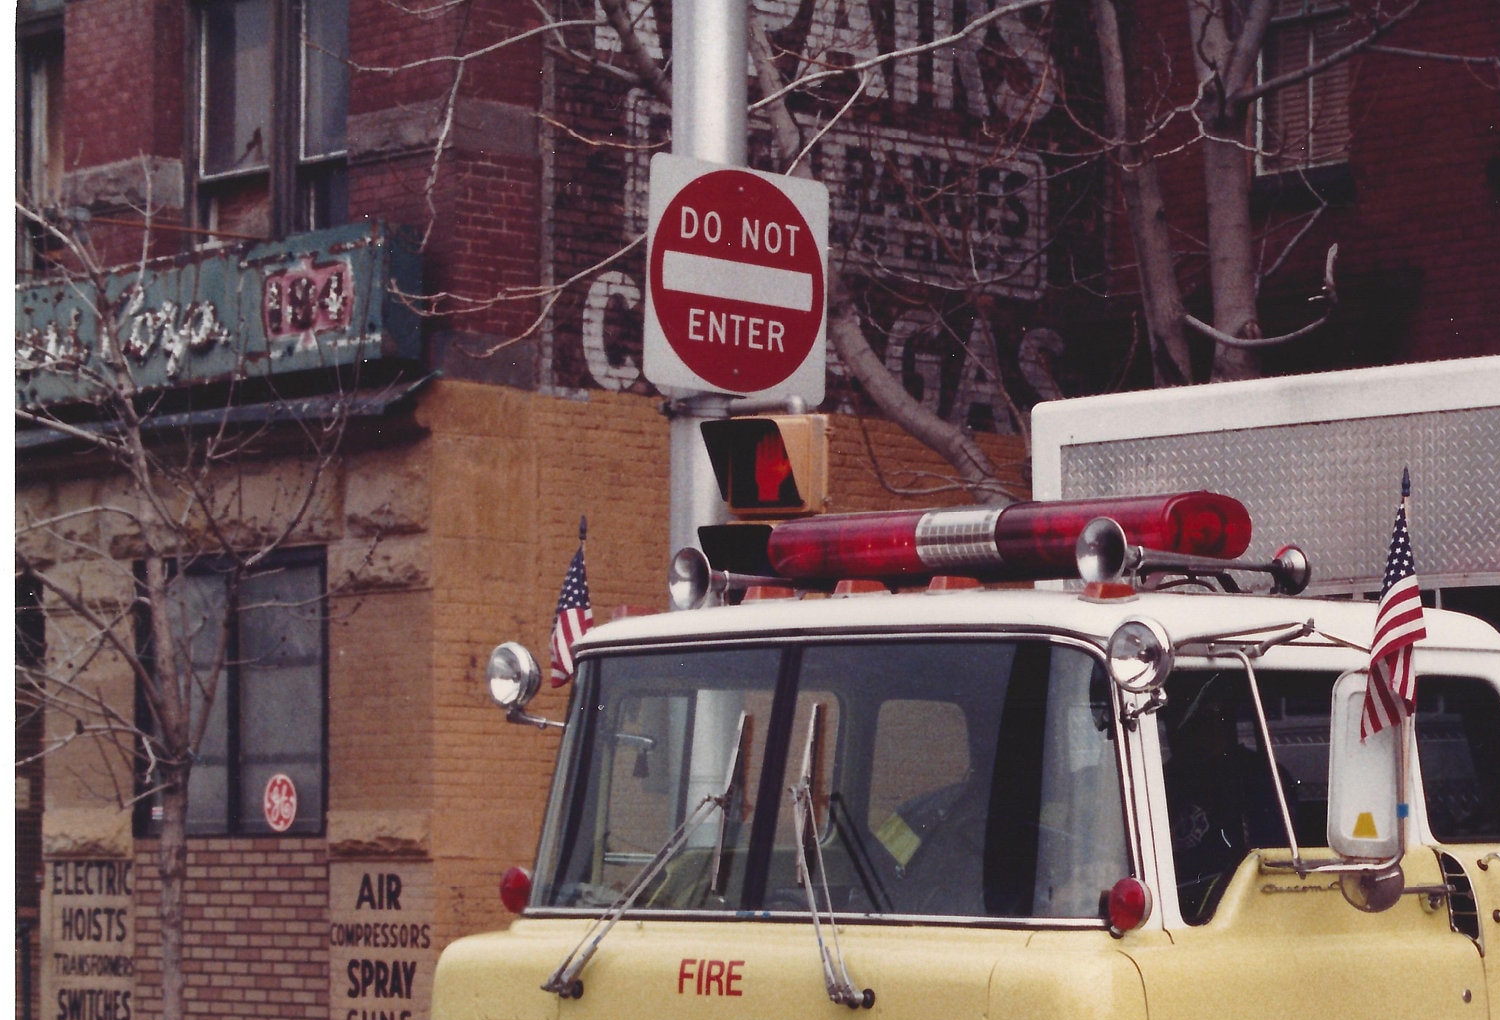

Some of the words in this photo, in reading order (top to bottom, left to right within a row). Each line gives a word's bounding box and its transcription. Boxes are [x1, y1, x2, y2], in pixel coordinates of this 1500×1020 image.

[680, 206, 722, 243] DO
[741, 217, 800, 257] NOT
[688, 307, 785, 353] ENTER
[53, 861, 133, 896] ELECTRIC
[356, 873, 402, 910] AIR
[62, 906, 127, 941] HOISTS
[330, 922, 431, 949] COMPRESSORS
[347, 958, 417, 999] SPRAY
[678, 958, 745, 996] FIRE
